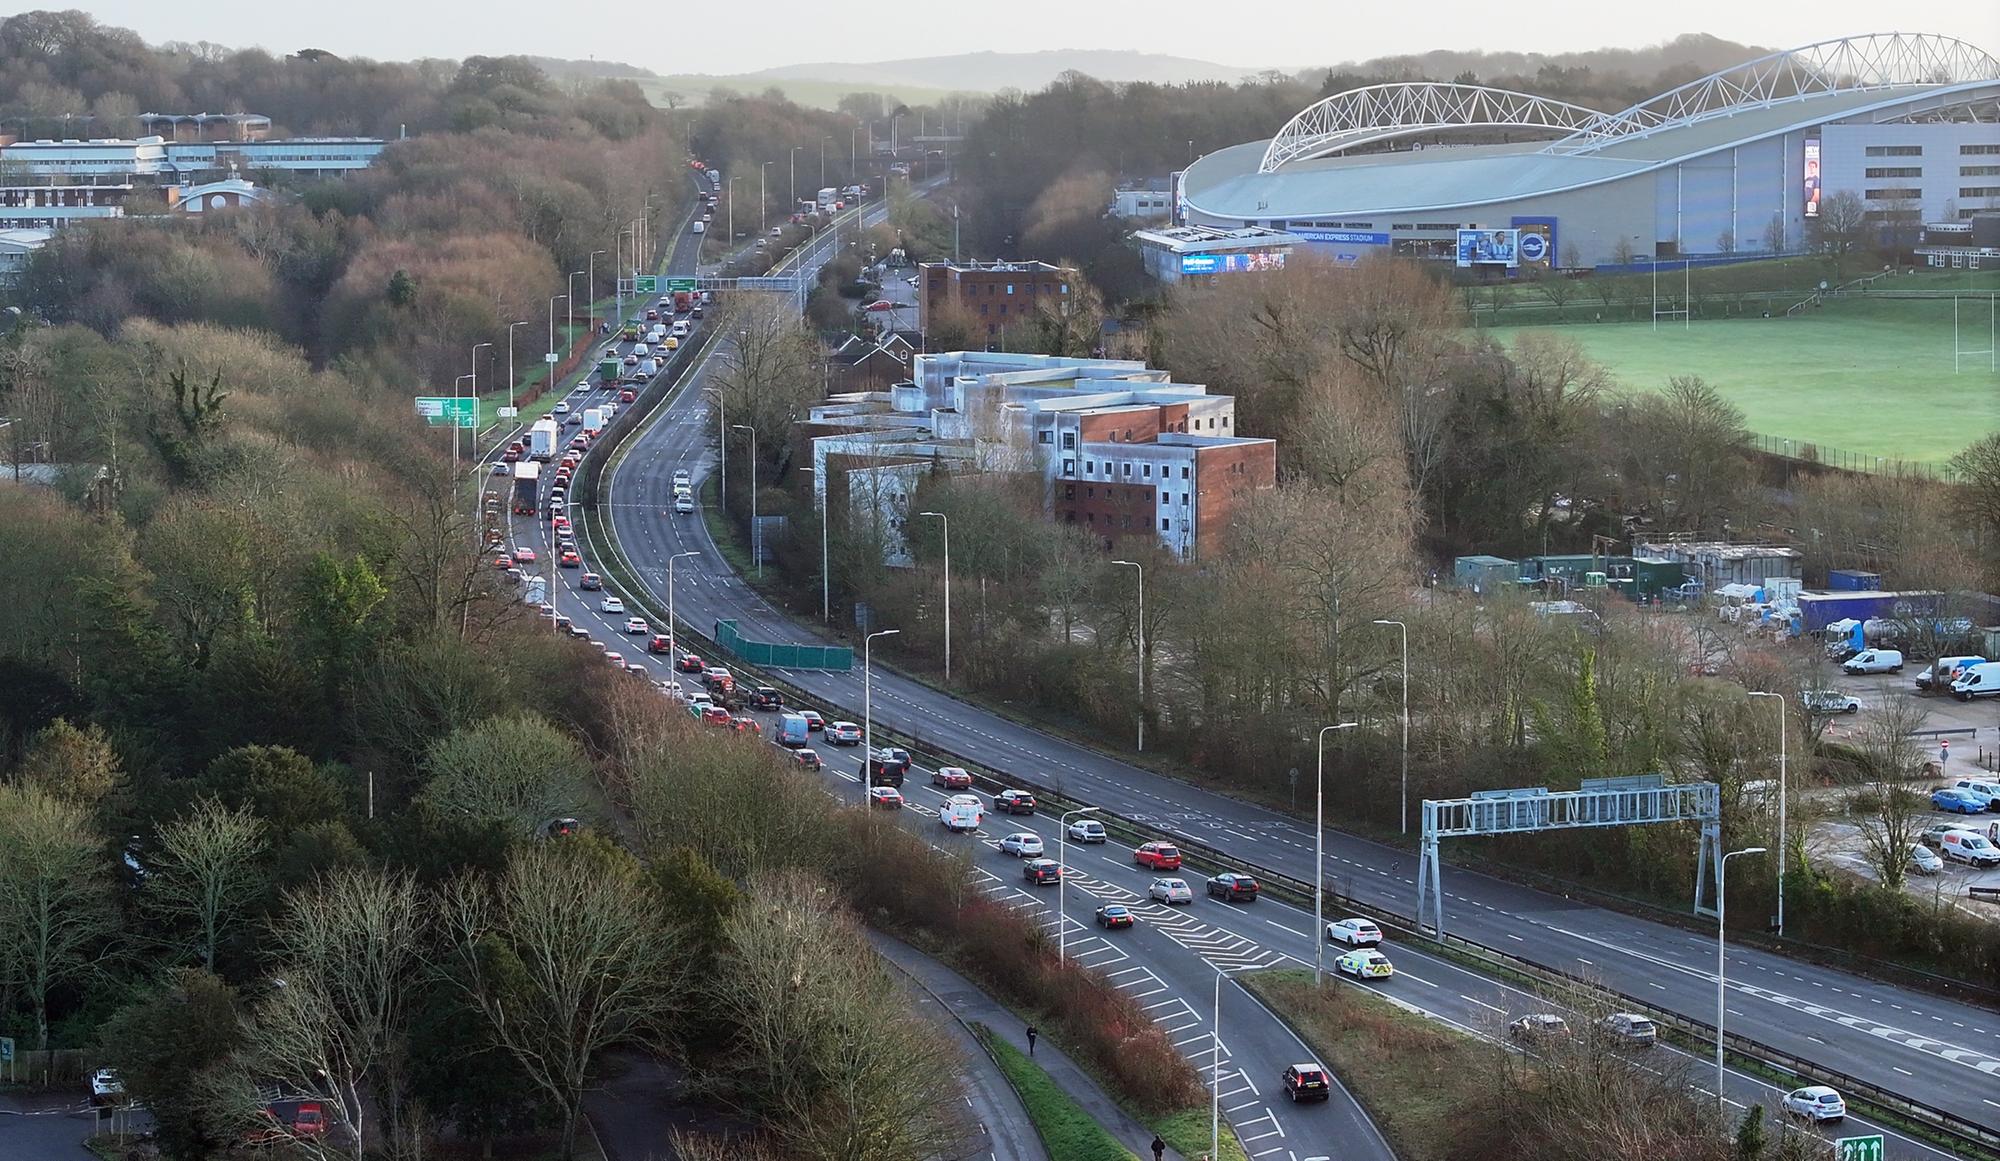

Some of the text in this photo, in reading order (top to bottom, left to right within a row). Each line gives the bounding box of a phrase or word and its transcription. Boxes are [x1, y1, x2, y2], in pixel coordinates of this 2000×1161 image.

[1295, 232, 1373, 242] MERICAN EXPRESS STADIUM
